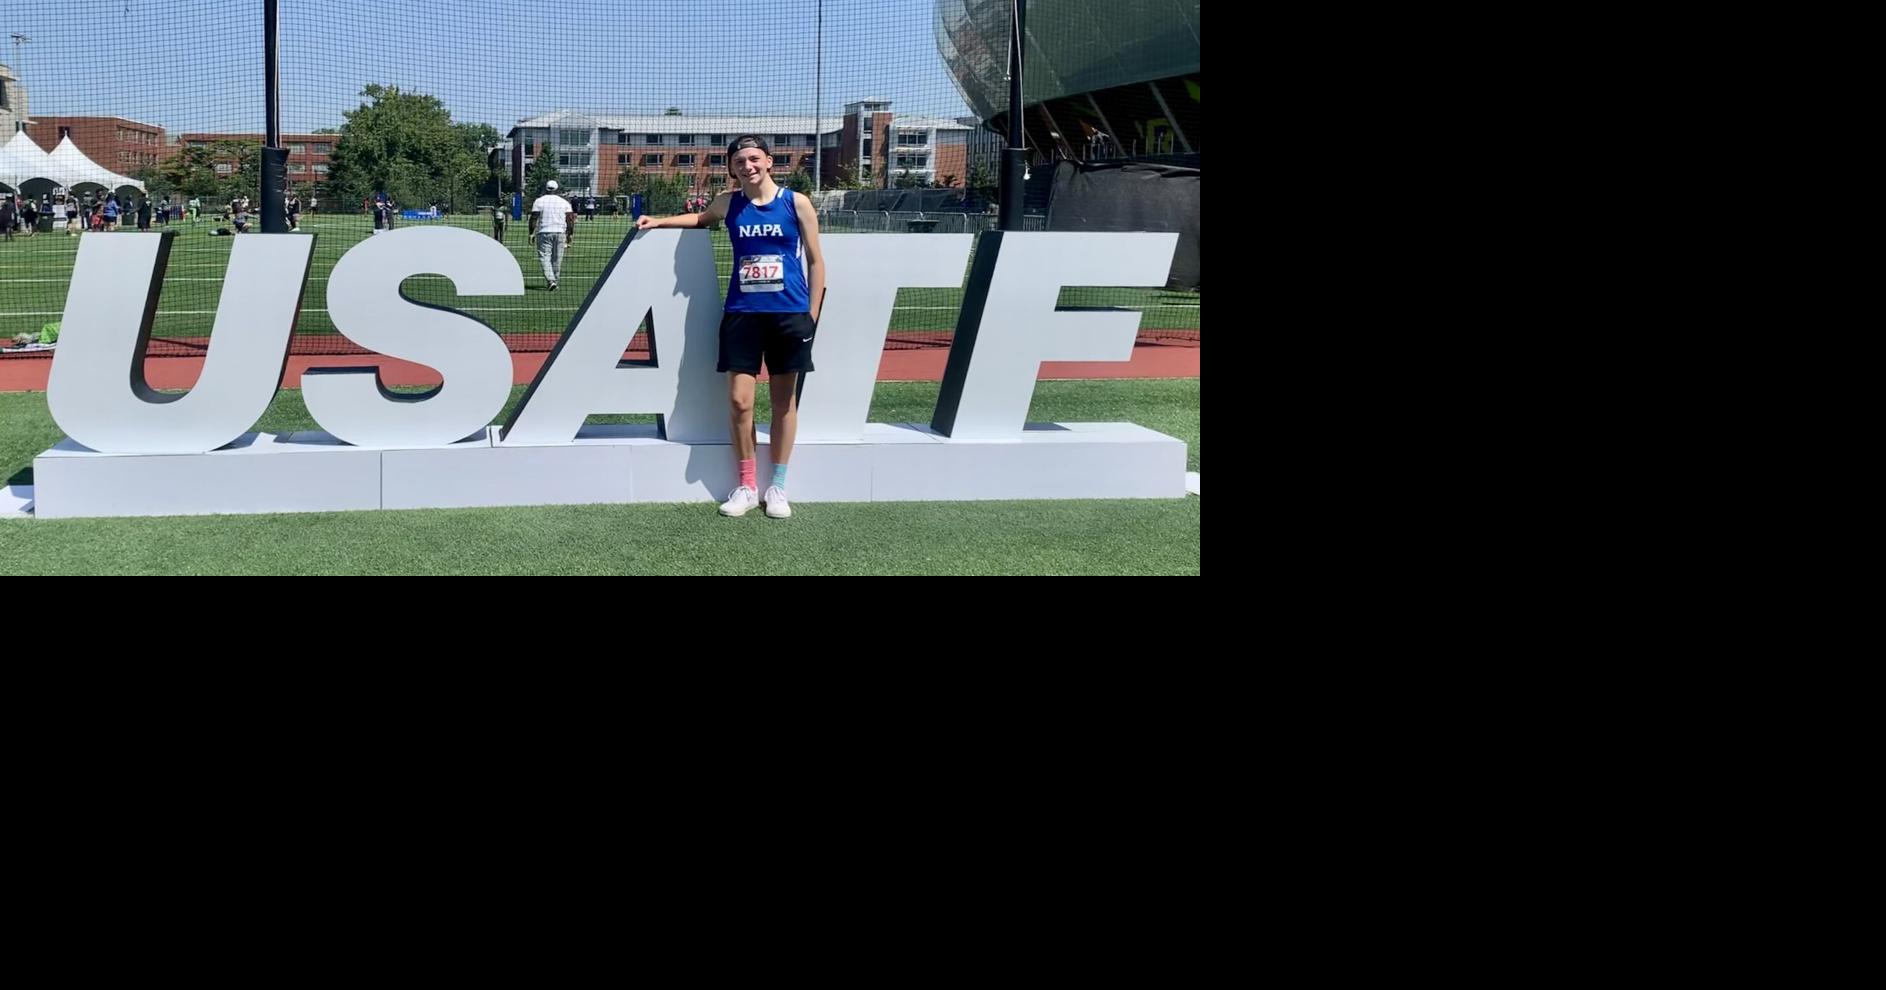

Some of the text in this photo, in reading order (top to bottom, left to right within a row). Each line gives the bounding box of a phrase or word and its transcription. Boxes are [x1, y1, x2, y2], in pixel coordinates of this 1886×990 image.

[739, 224, 783, 237] NAPA
[743, 265, 779, 279] 7817
[47, 225, 1180, 454] USATF
